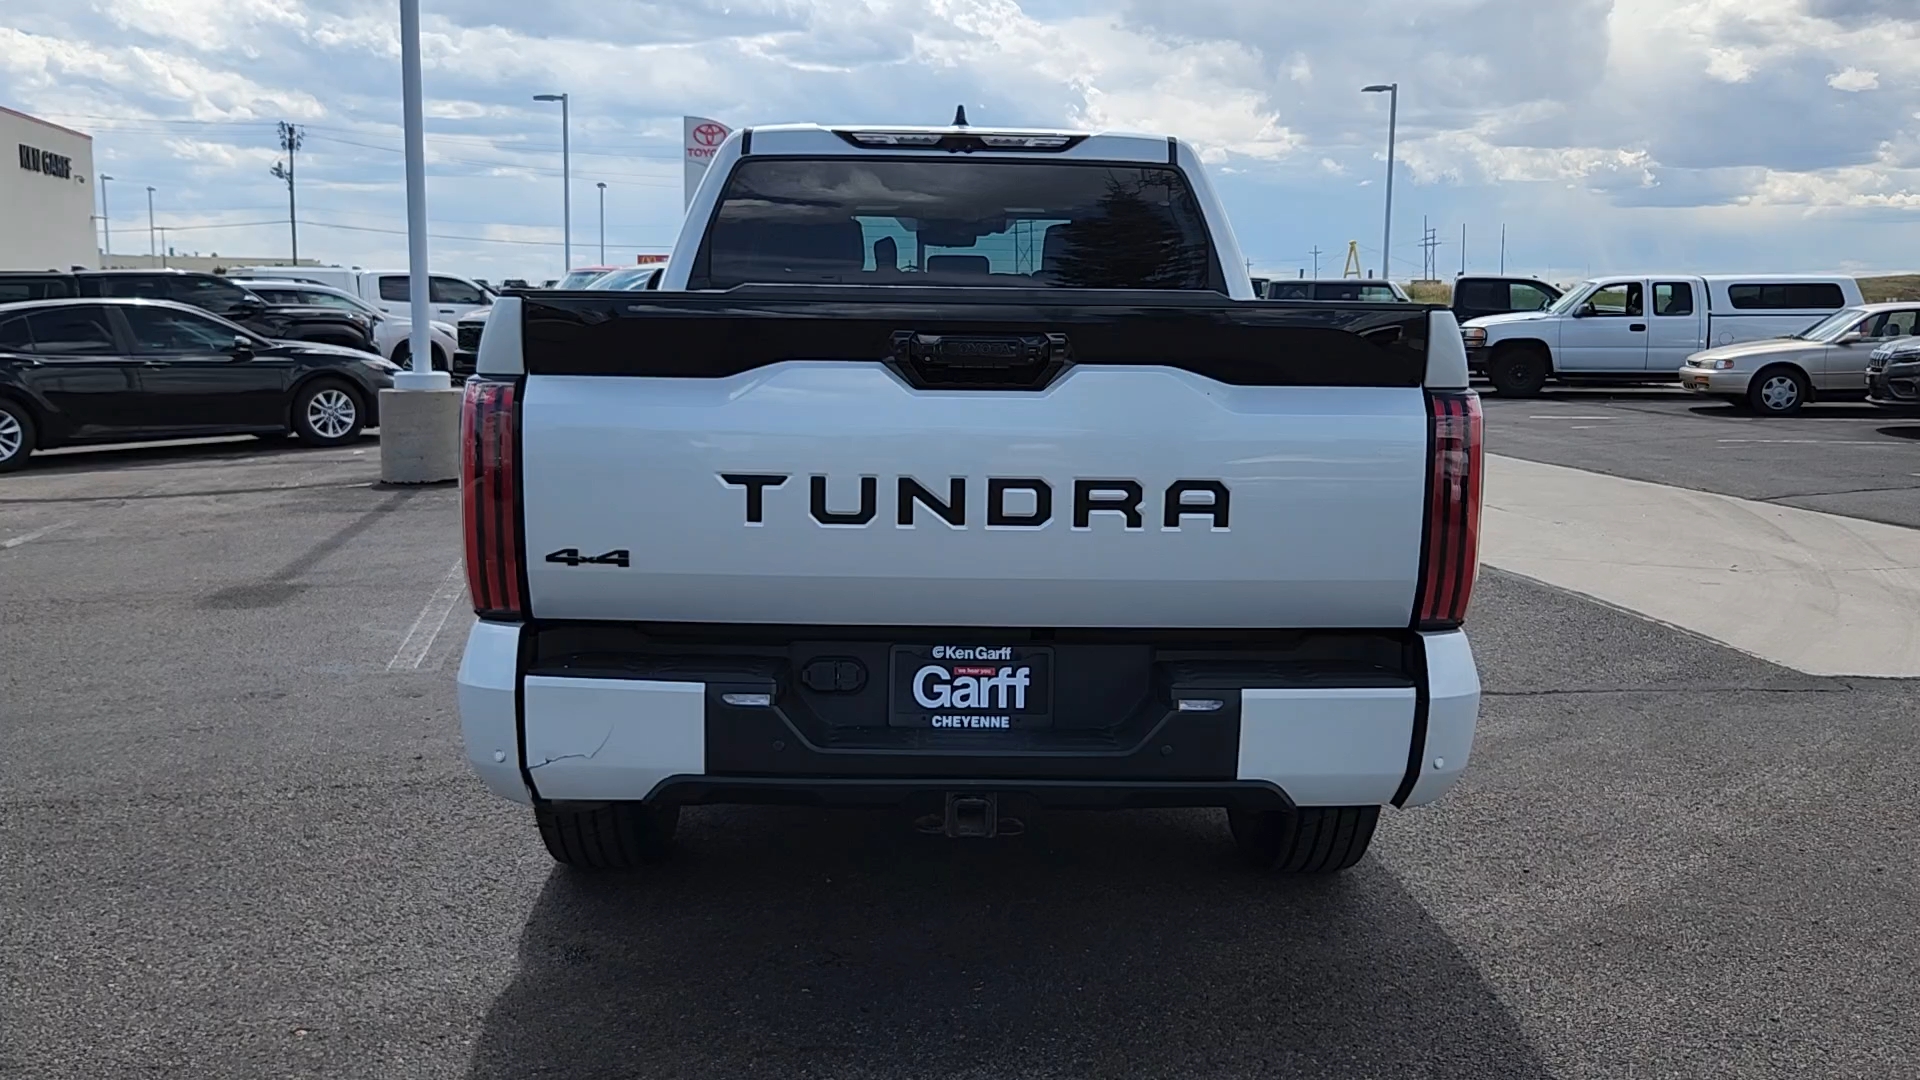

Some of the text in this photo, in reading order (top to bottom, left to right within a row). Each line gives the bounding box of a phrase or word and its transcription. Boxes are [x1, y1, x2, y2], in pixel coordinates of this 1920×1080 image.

[688, 148, 718, 157] TOYO
[715, 473, 1232, 533] TUNDRA
[945, 646, 1012, 660] Ken Garff
[912, 665, 1030, 709] Garff
[931, 715, 1010, 729] CHEYENNE
